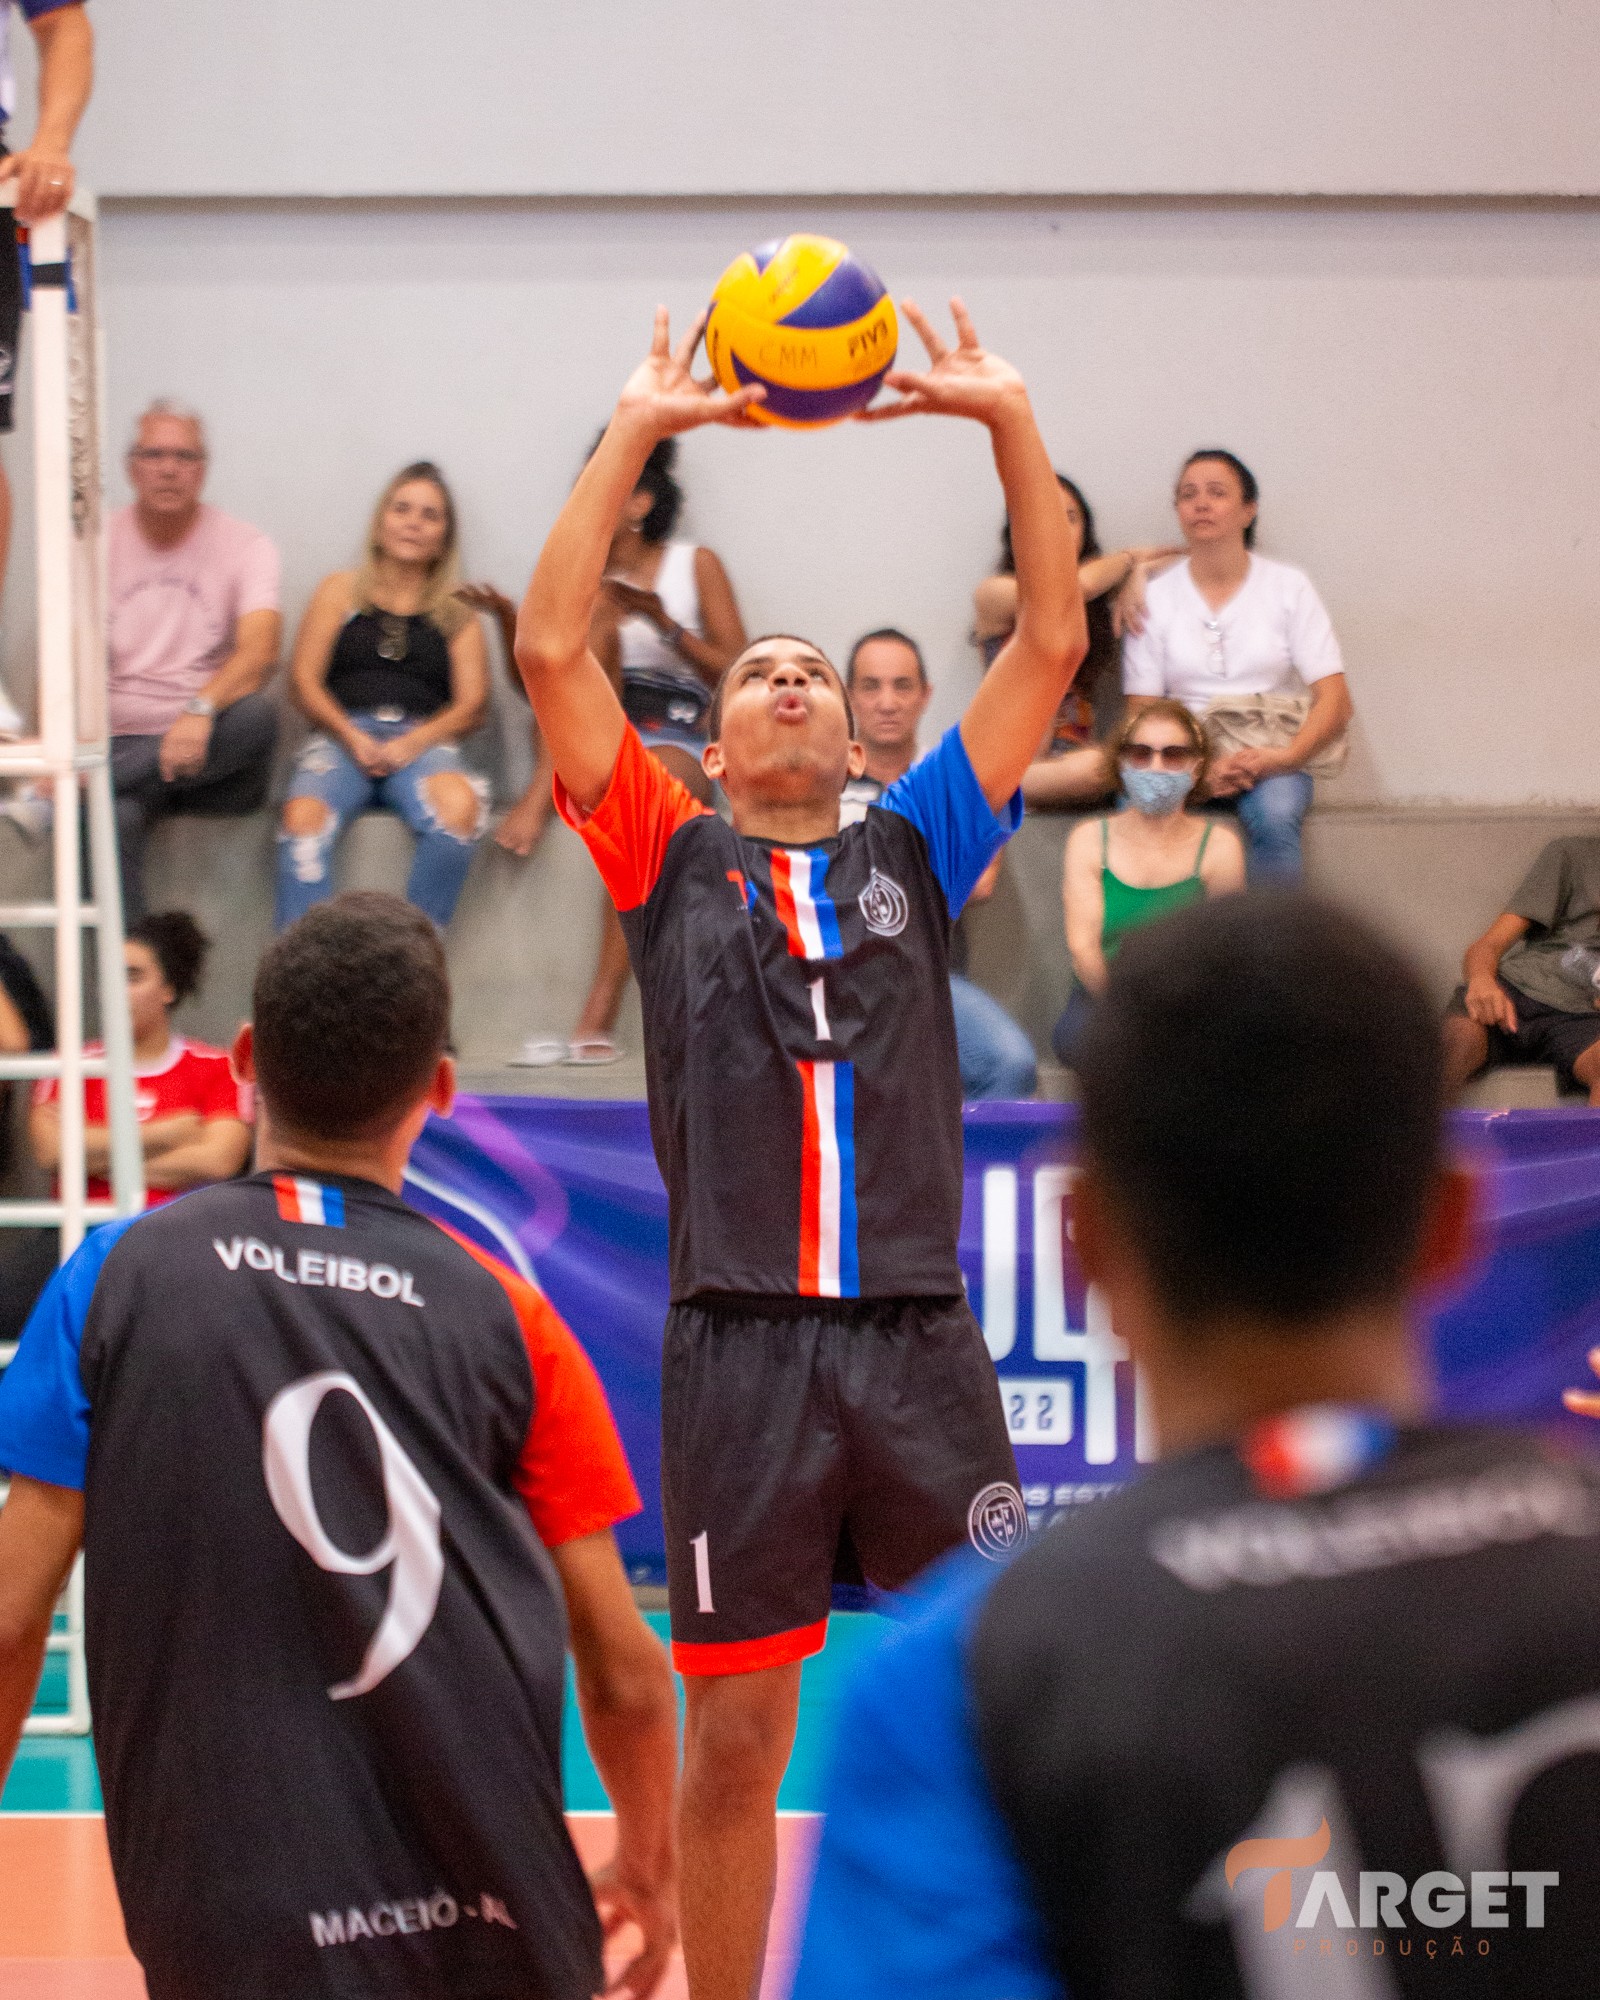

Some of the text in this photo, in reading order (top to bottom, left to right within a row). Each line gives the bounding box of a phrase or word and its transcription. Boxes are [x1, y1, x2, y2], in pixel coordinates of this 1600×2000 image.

[806, 977, 832, 1041] 1
[213, 1237, 426, 1307] VOLEIBOL
[263, 1371, 444, 1700] 9
[689, 1530, 716, 1613] 1
